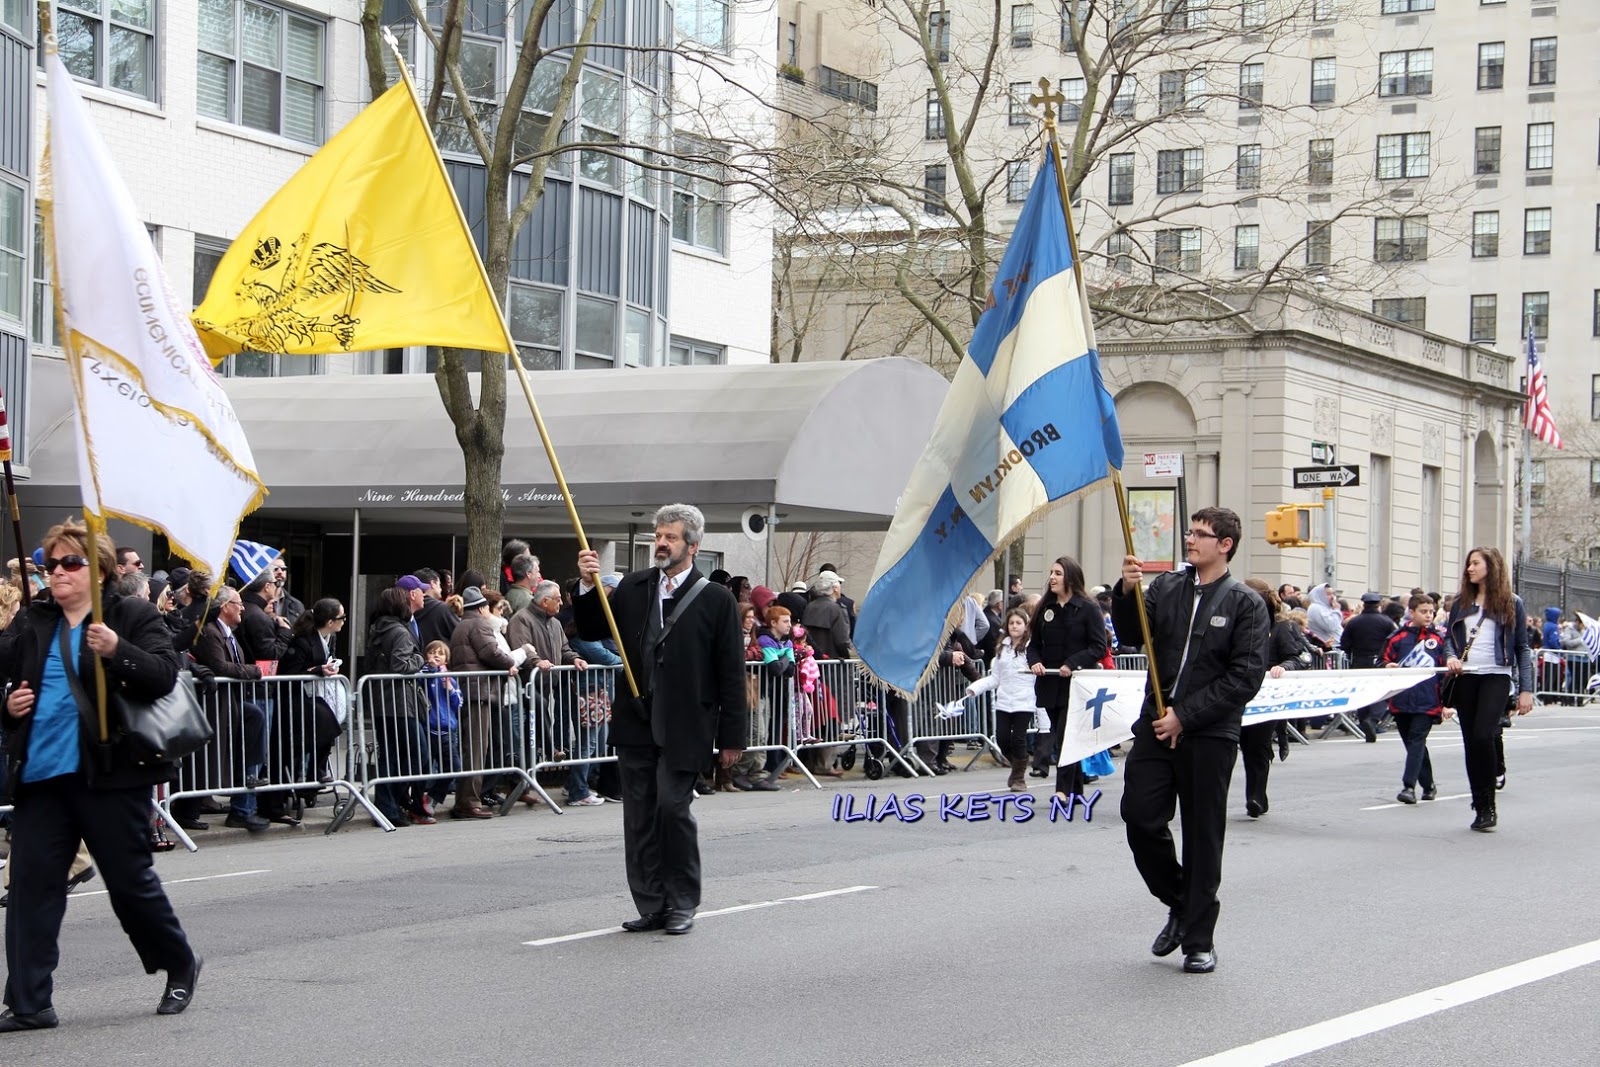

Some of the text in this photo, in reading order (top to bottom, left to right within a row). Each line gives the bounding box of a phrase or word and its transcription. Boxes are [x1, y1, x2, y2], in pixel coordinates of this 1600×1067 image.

[1145, 454, 1156, 465] NO
[1302, 471, 1350, 483] ONE WAY
[358, 488, 396, 502] Nine
[400, 488, 466, 502] Hundred
[1299, 699, 1335, 709] N.Y.
